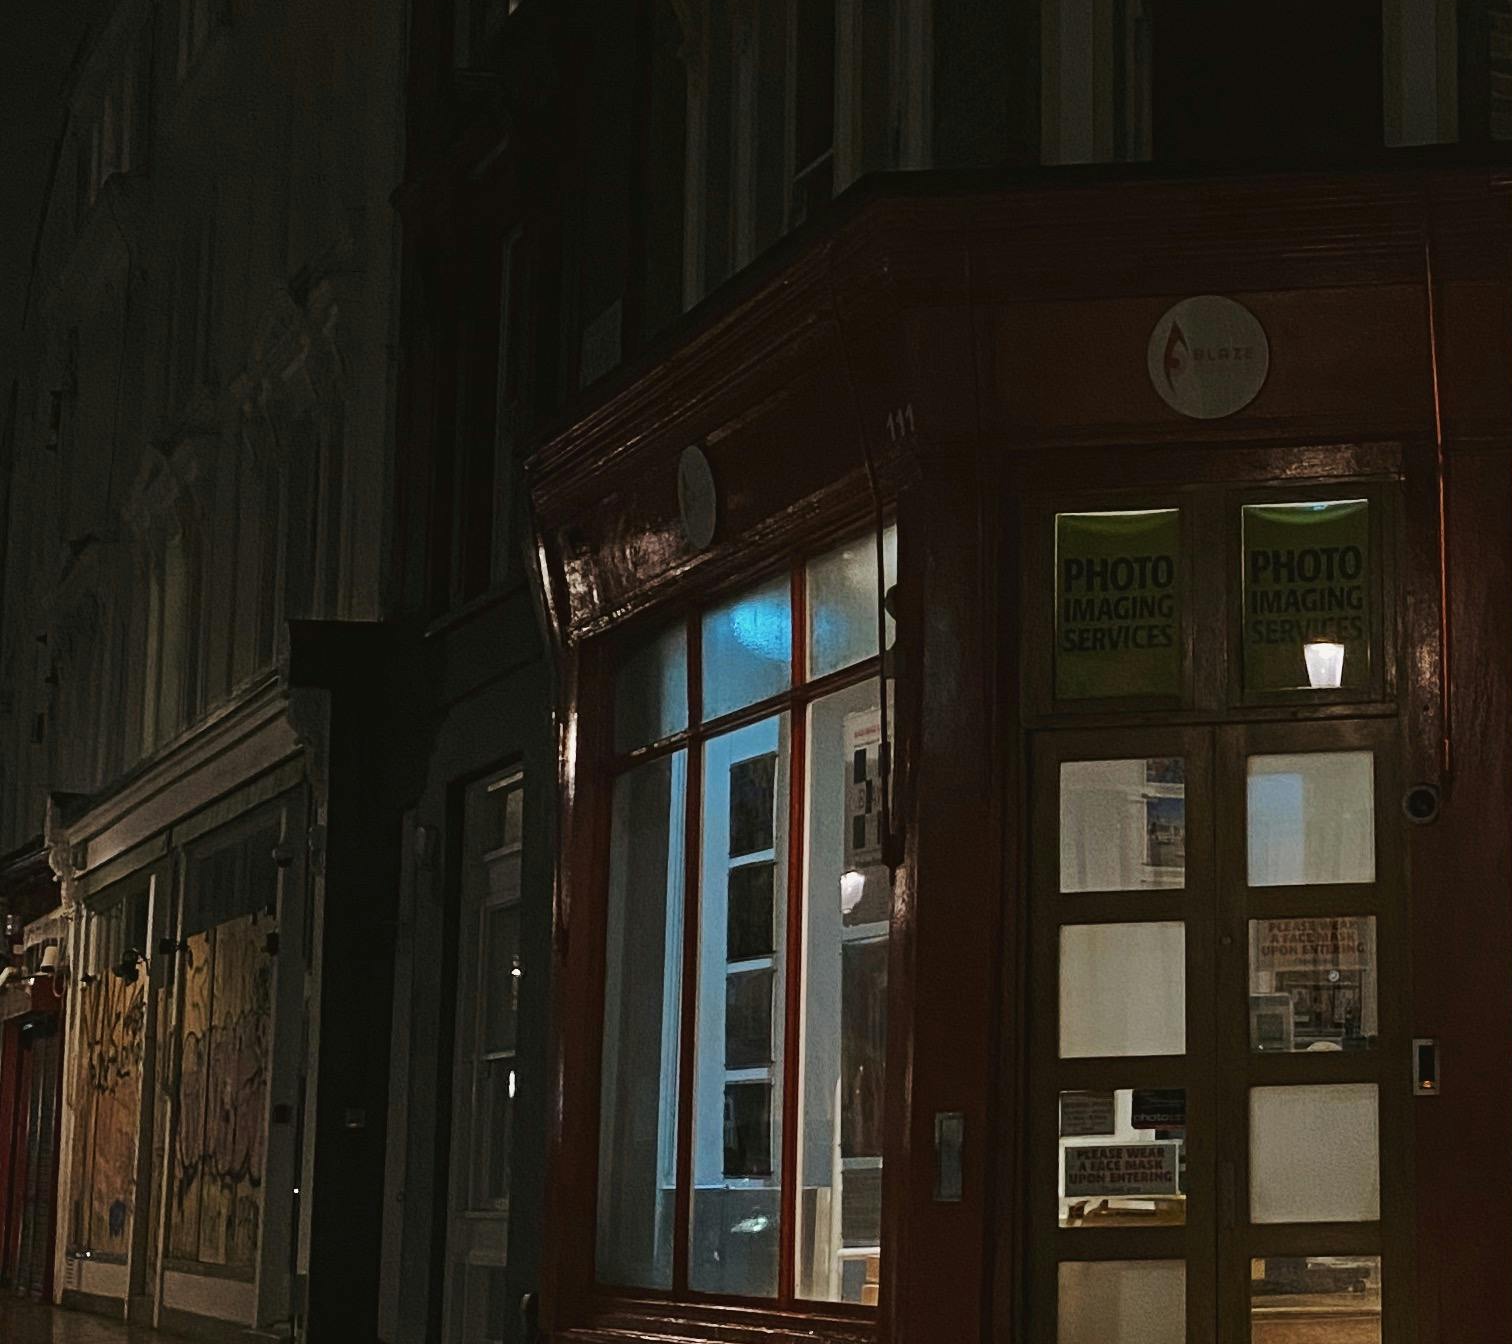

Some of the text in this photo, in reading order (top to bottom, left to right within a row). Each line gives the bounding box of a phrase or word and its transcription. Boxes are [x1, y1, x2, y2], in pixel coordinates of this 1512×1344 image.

[1193, 346, 1254, 361] BLAZE
[886, 402, 915, 442] 111
[1063, 556, 1173, 592] PHOTO
[1250, 545, 1361, 584] PHOTO
[1063, 594, 1173, 622] IMAGING
[1249, 585, 1362, 614] IMAGING
[1063, 624, 1173, 652] SERVICES
[1250, 616, 1362, 644] SERVICES
[1109, 1171, 1172, 1183] ENTERING
